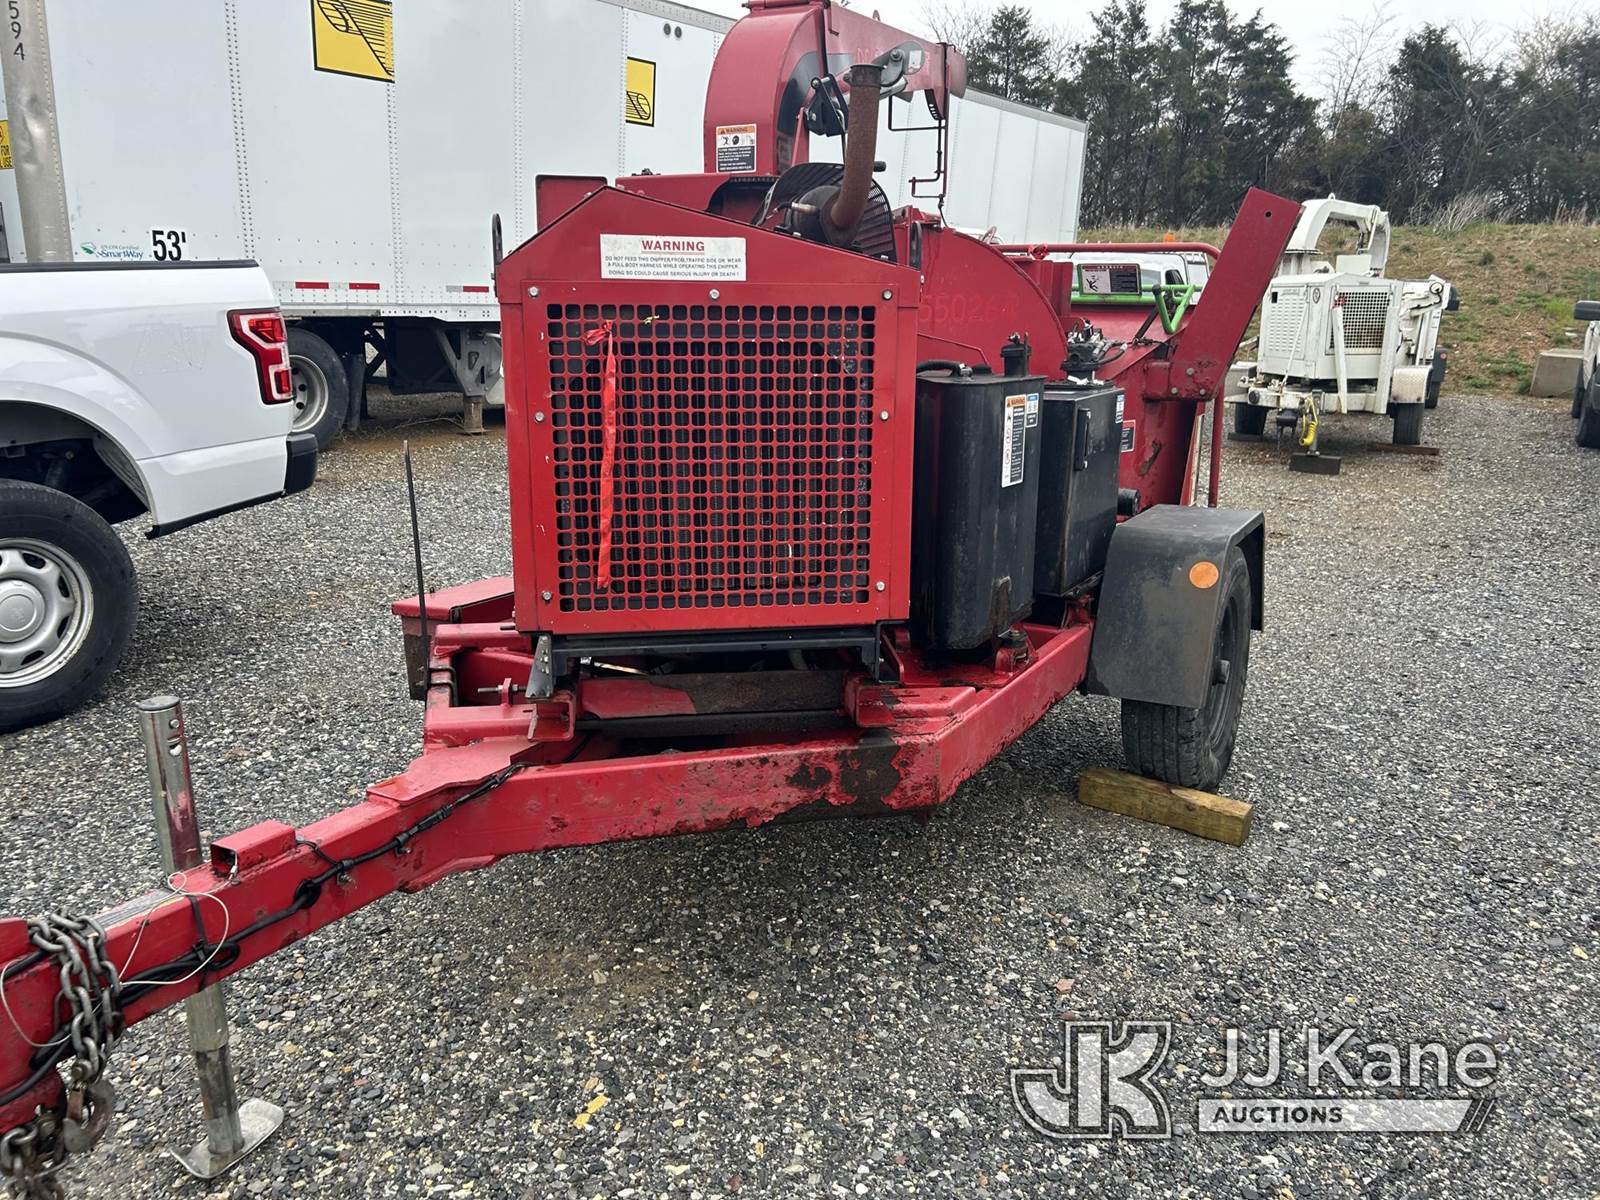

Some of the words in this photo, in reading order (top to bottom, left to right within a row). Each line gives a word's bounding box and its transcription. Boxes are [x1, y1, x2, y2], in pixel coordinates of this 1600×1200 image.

[152, 230, 186, 261] 53'
[642, 240, 704, 251] WARNING
[102, 250, 143, 258] SmartWay
